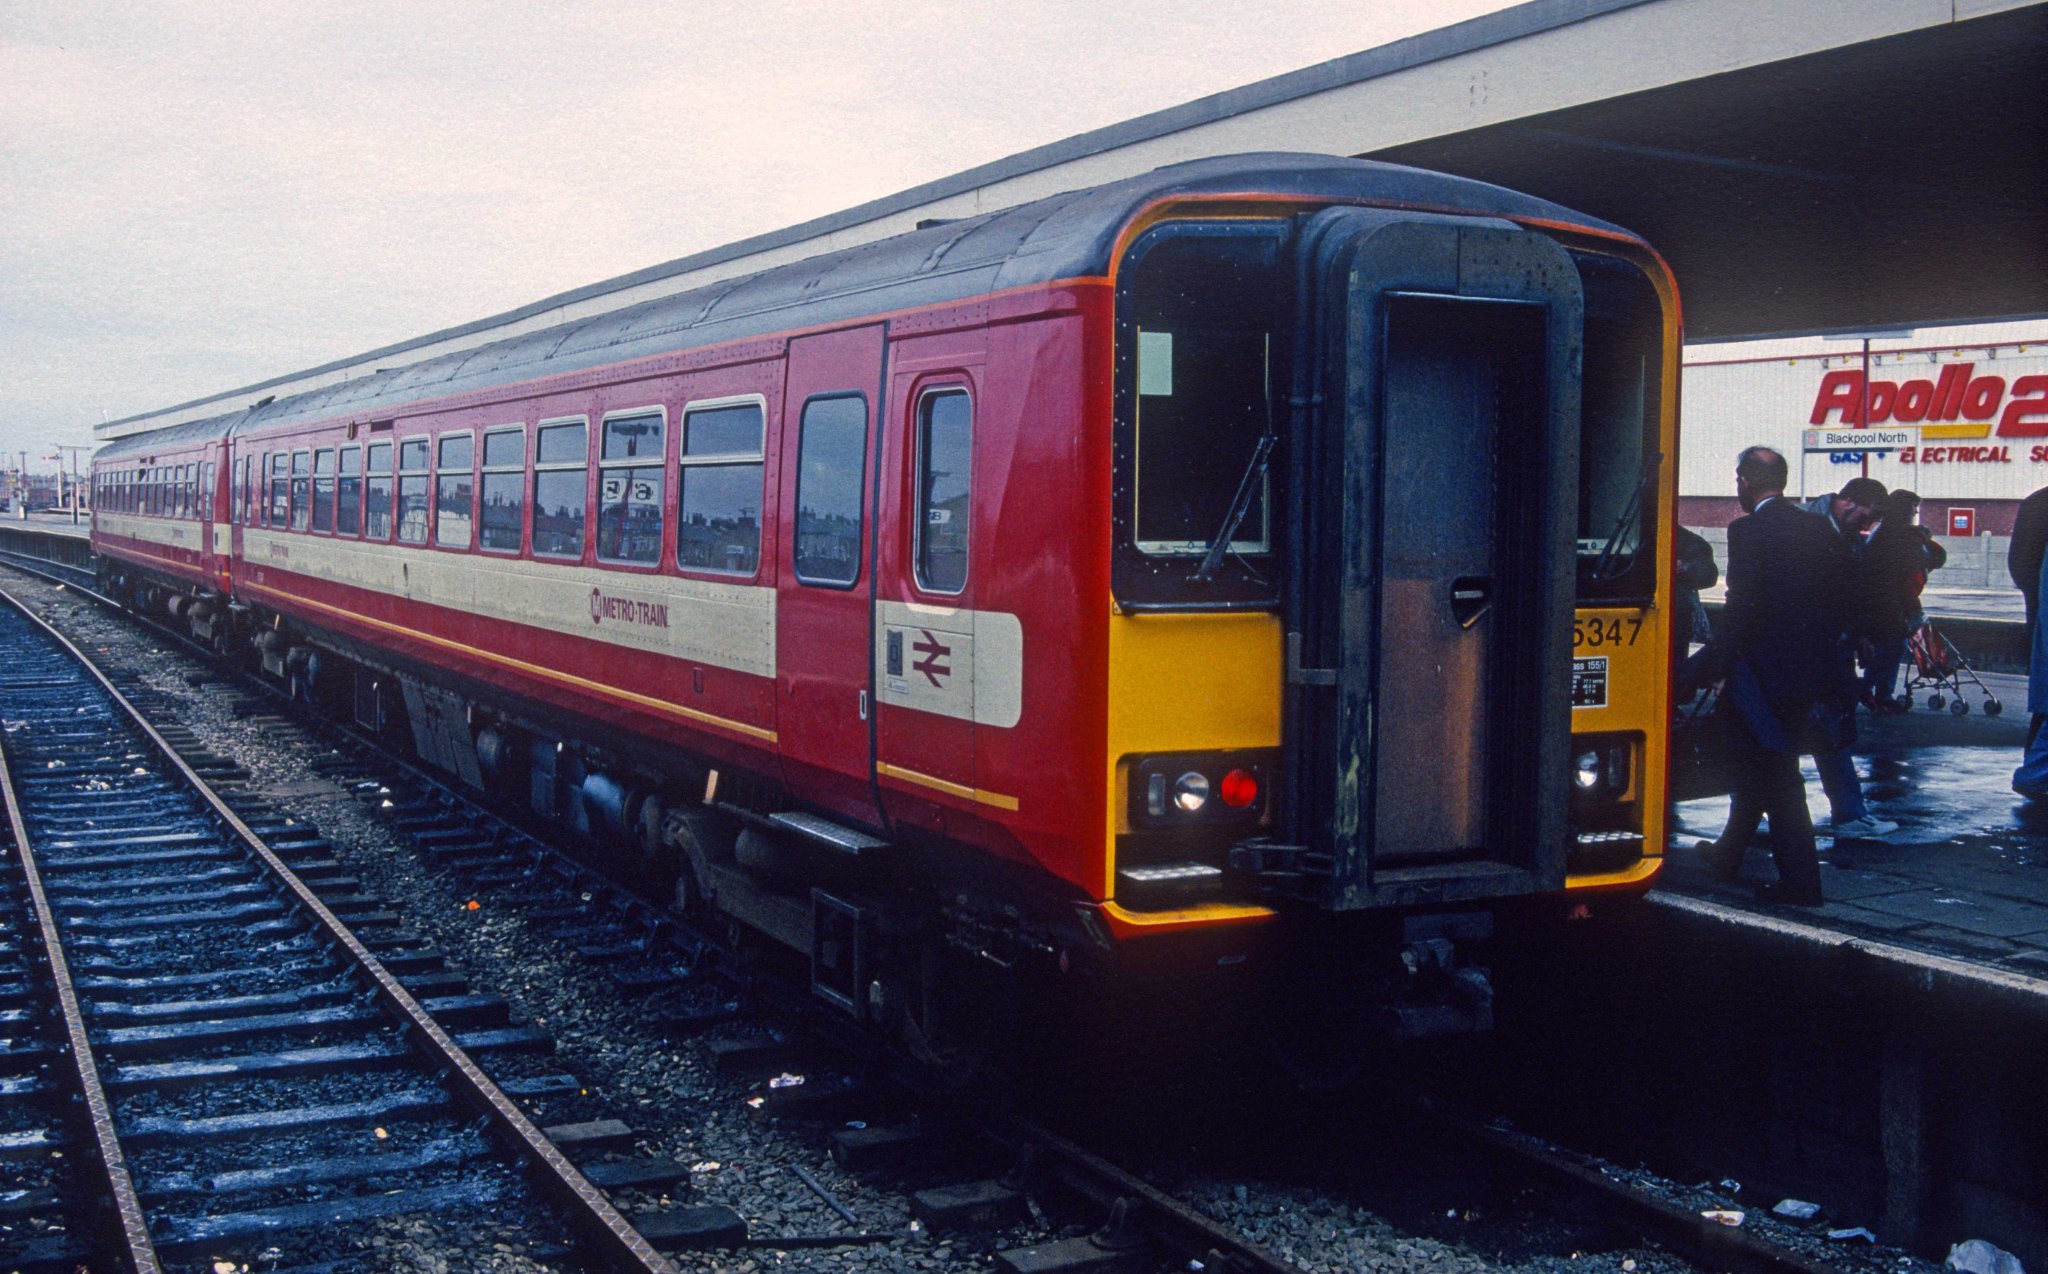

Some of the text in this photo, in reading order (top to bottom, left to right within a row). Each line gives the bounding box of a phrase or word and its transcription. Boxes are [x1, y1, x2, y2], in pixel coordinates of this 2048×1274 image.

[1810, 362, 2006, 430] Apollo
[1826, 432, 1908, 445] Blackpool North
[1587, 660, 1605, 670] 155/1
